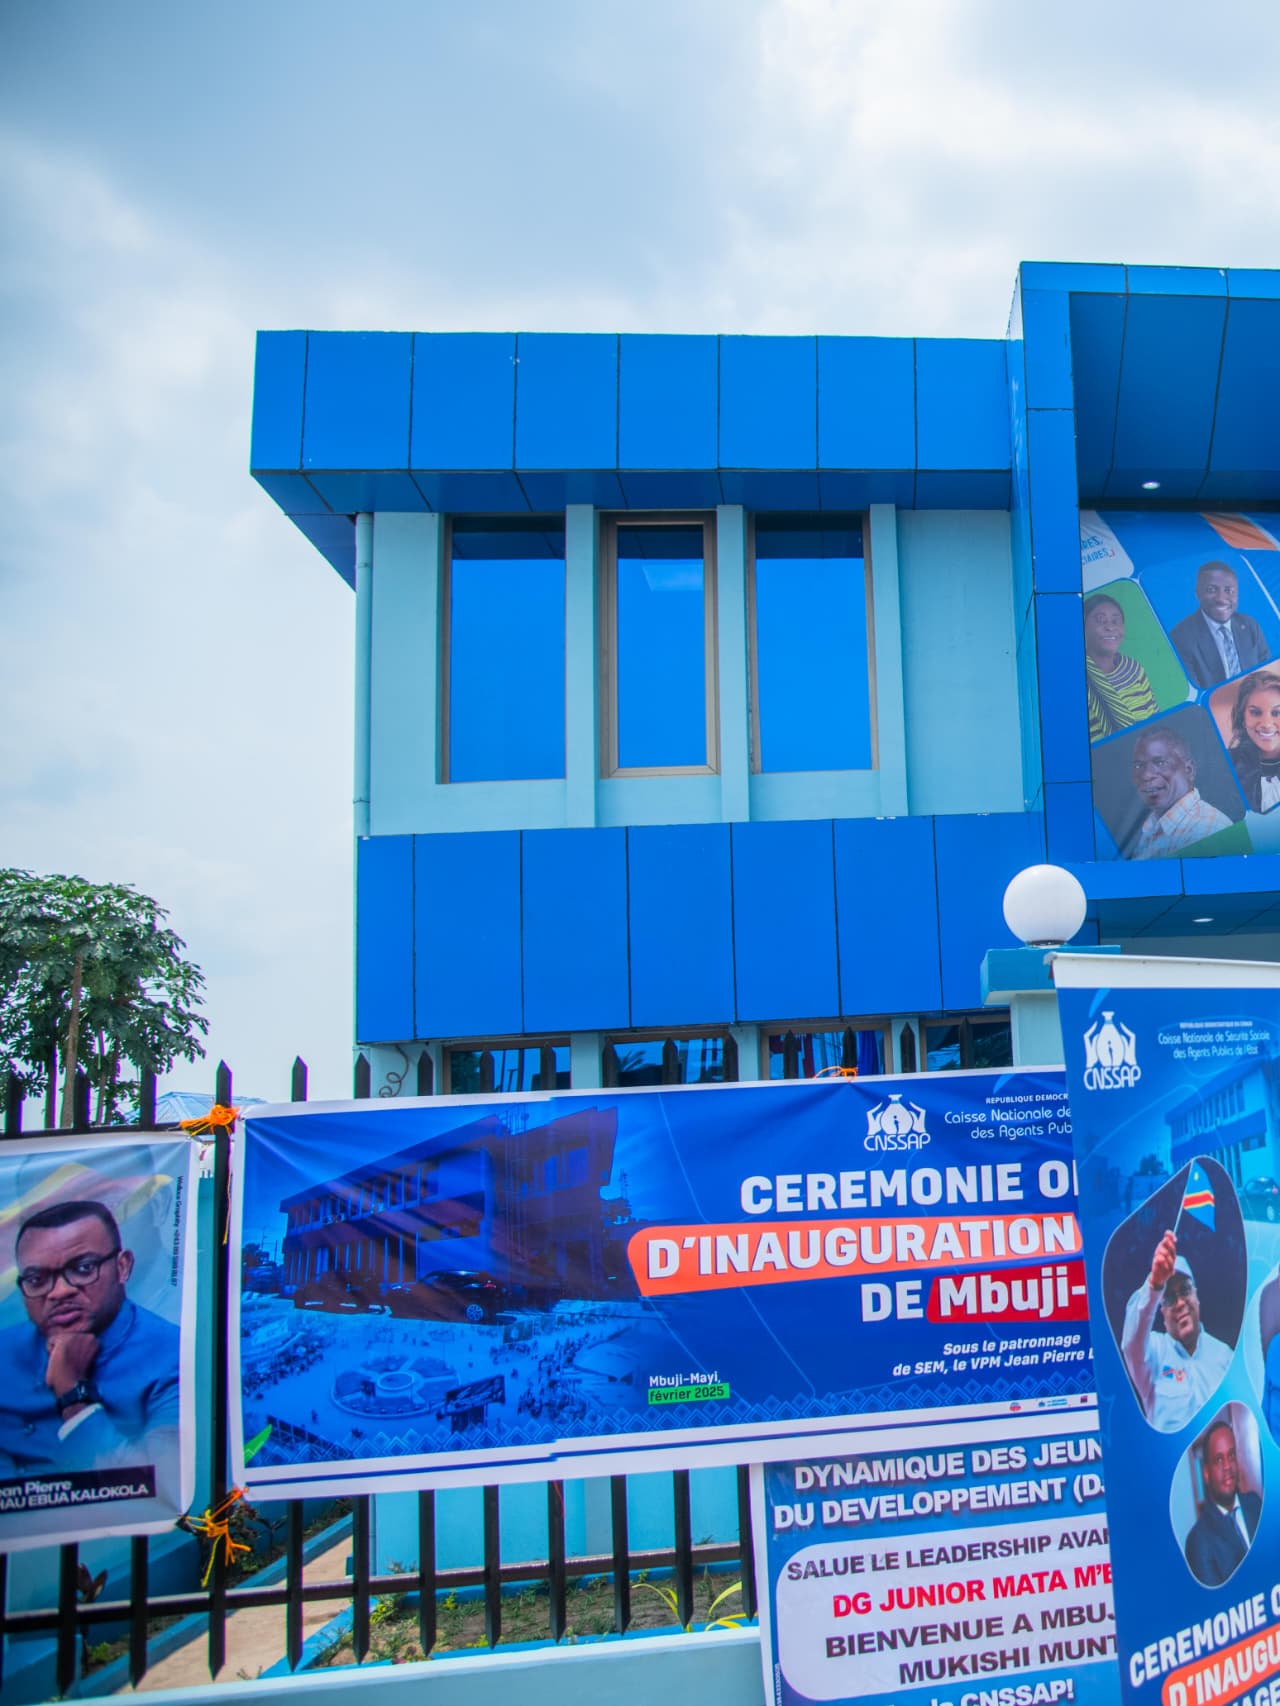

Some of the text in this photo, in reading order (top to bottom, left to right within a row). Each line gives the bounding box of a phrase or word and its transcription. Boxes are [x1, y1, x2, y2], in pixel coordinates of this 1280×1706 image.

[1083, 1066, 1141, 1091] CNSSAP
[986, 1095, 1034, 1104] REPUBLIQUE
[944, 1111, 986, 1124] Caisse
[991, 1106, 1053, 1121] Nationale
[864, 1132, 931, 1151] CNSSAP
[971, 1128, 995, 1139] des
[999, 1125, 1044, 1141] Agents
[740, 1159, 1079, 1215] CEREMONIE O
[647, 1214, 1076, 1280] D'INAUGURATION
[861, 1265, 1086, 1322] DE Mbuji-
[943, 1333, 1081, 1355] Sous le patronnage
[893, 1363, 911, 1377] de
[914, 1360, 948, 1375] SEM,
[953, 1358, 967, 1371] le
[971, 1355, 1001, 1369] VPM
[1004, 1353, 1039, 1368] Jean
[1042, 1349, 1084, 1364] Pierre
[649, 1370, 721, 1387] Mbuji-Mayi,
[649, 1385, 725, 1402] février 2025
[794, 1438, 1103, 1490] DYNAMIQUE DES JEUN
[25, 1480, 72, 1495] Pierre
[28, 1493, 70, 1507] EBUA
[71, 1483, 149, 1502] KALOKOLA
[774, 1502, 815, 1529] DU
[822, 1477, 1066, 1524] DEVELOPPEMENT
[787, 1555, 865, 1581] SALUE
[871, 1552, 899, 1572] LE
[906, 1535, 1051, 1568] LEADERSHIP
[832, 1592, 872, 1618] DG
[879, 1579, 986, 1612] JUNIOR
[992, 1569, 1068, 1599] MATA
[825, 1616, 1004, 1658] BIENVENUE
[1012, 1613, 1034, 1634] A
[1129, 1591, 1267, 1688] CEREMONIE
[899, 1646, 1031, 1685] MUKISHI
[960, 1678, 1075, 1706] CNSSAP!
